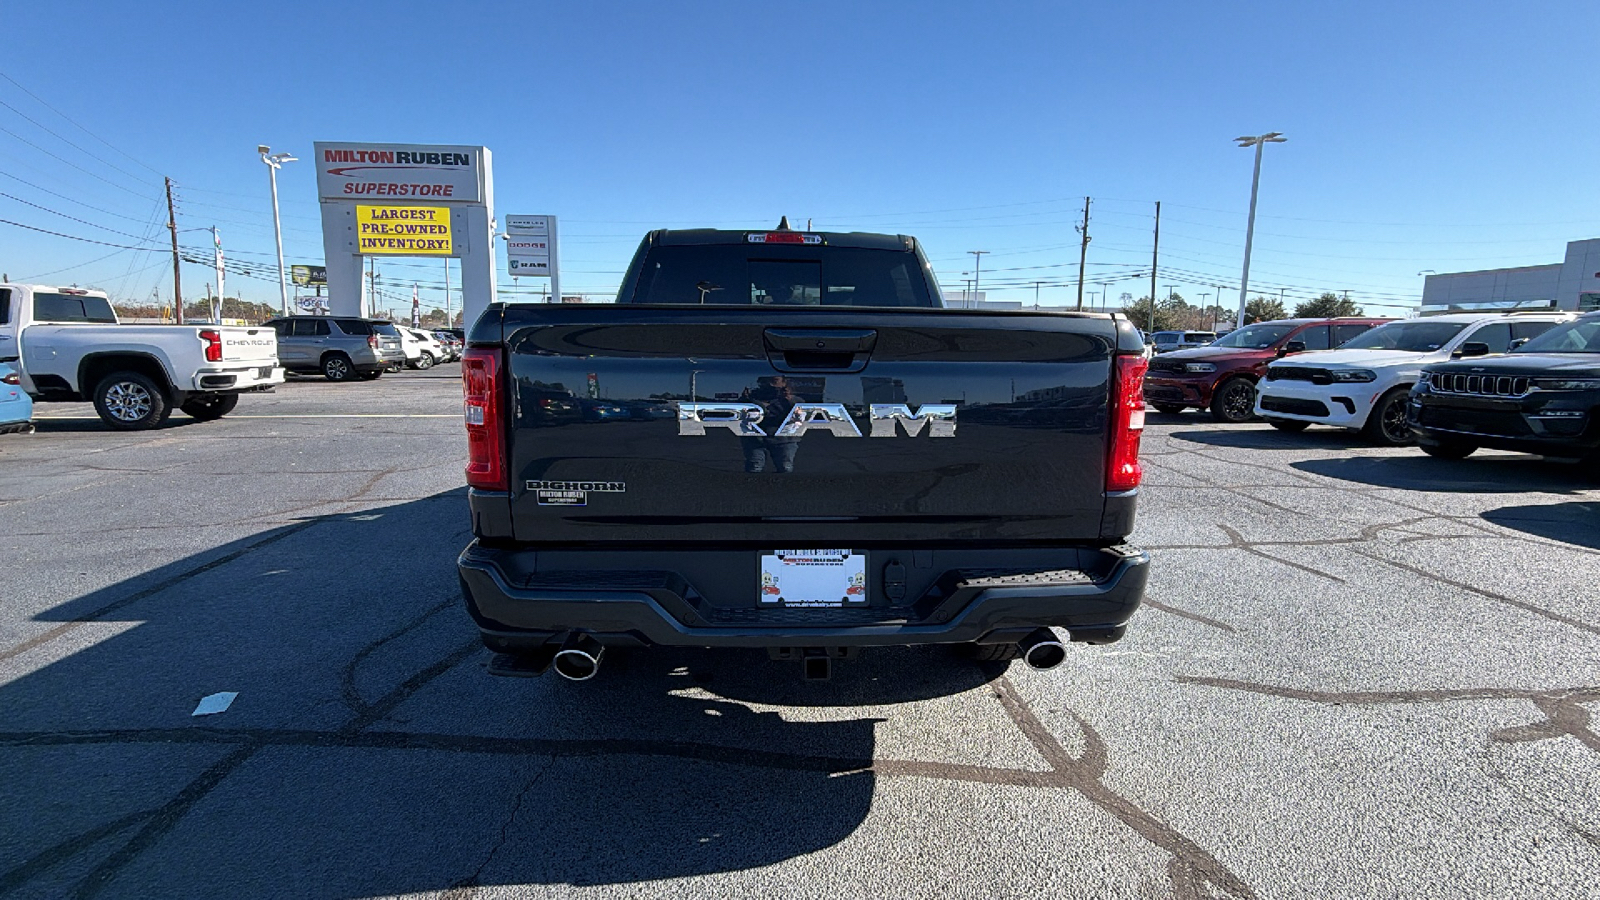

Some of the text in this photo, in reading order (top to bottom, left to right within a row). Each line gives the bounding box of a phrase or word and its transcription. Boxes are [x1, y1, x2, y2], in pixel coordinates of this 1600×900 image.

[325, 150, 470, 165] MILTON RUBEN
[343, 182, 454, 196] SUPERSTORE
[371, 209, 436, 220] LARGEST
[361, 223, 448, 234] PRE-OWNED
[361, 238, 450, 249] INVENTORY!
[678, 403, 957, 438] RAM
[526, 480, 626, 492] BIGHORN
